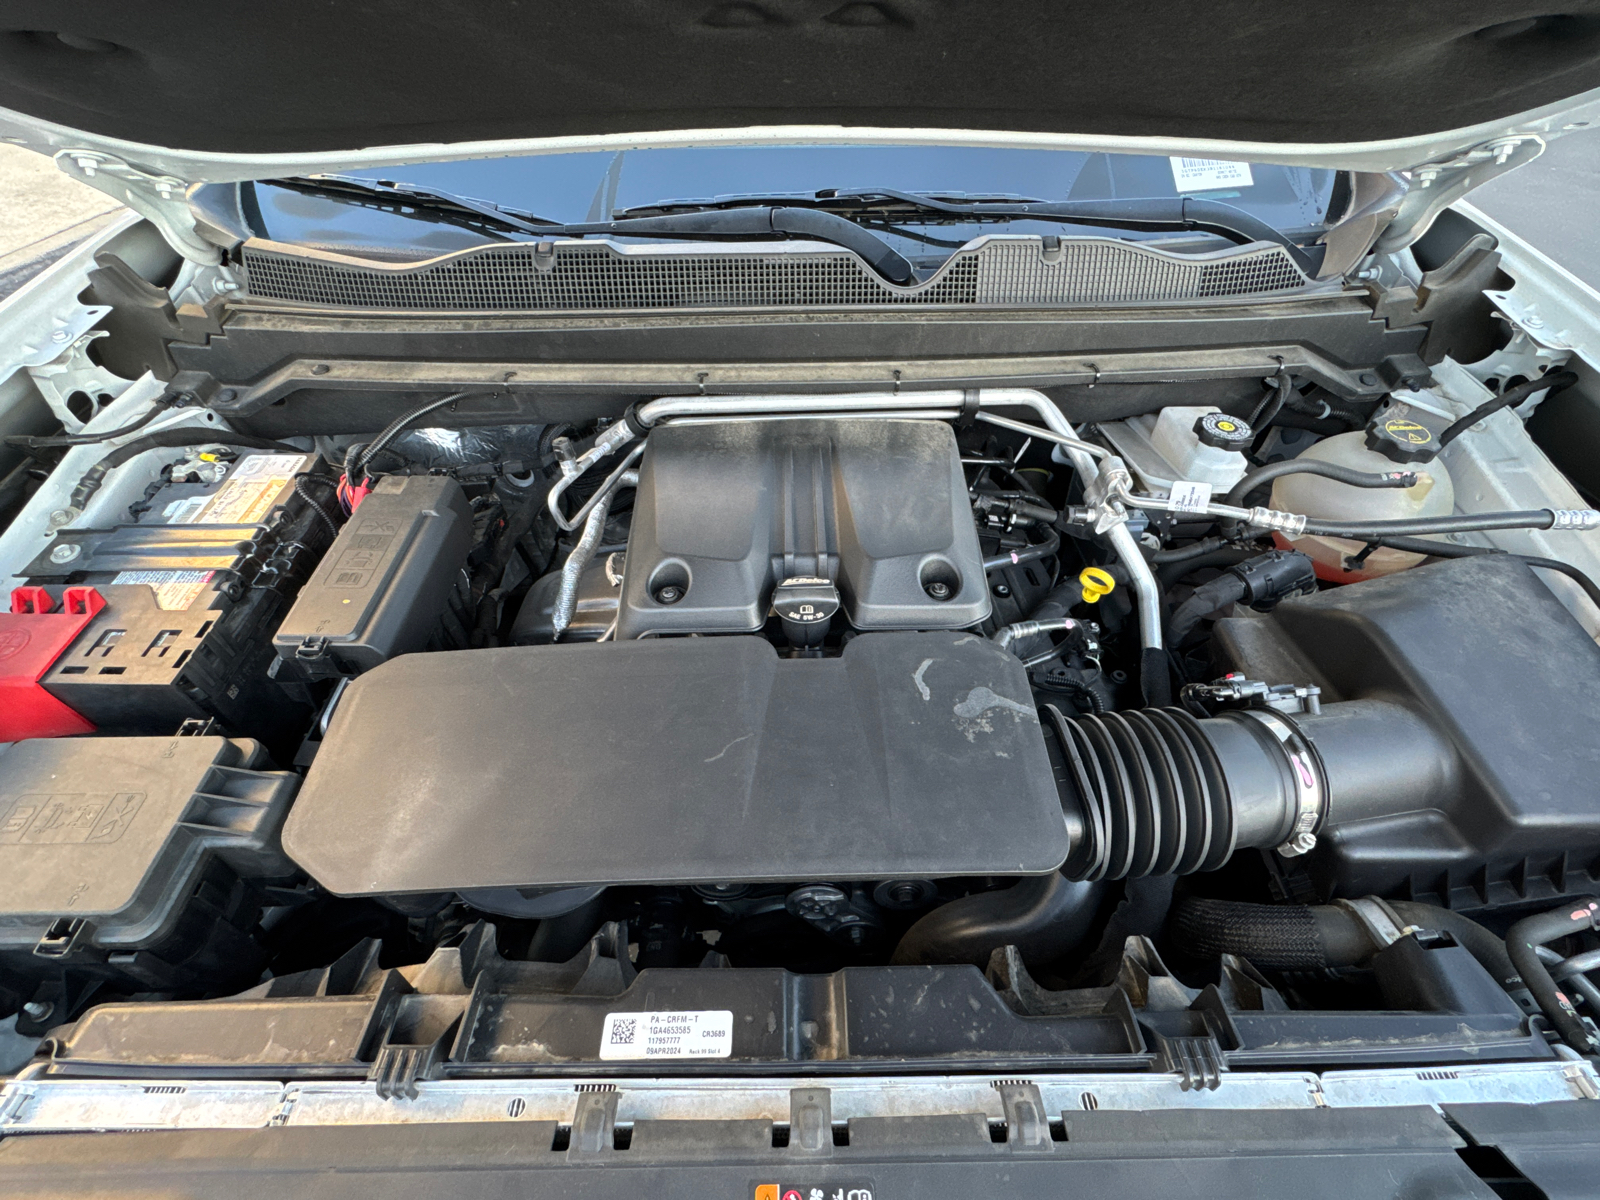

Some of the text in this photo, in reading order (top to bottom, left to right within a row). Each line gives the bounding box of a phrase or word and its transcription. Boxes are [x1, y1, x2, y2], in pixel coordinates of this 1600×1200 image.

[781, 578, 830, 586] ACDelco
[789, 612, 801, 620] SAE
[649, 1026, 691, 1035] 1GA4653585
[702, 1030, 726, 1038] CR3689
[646, 1046, 681, 1055] 09APR2024
